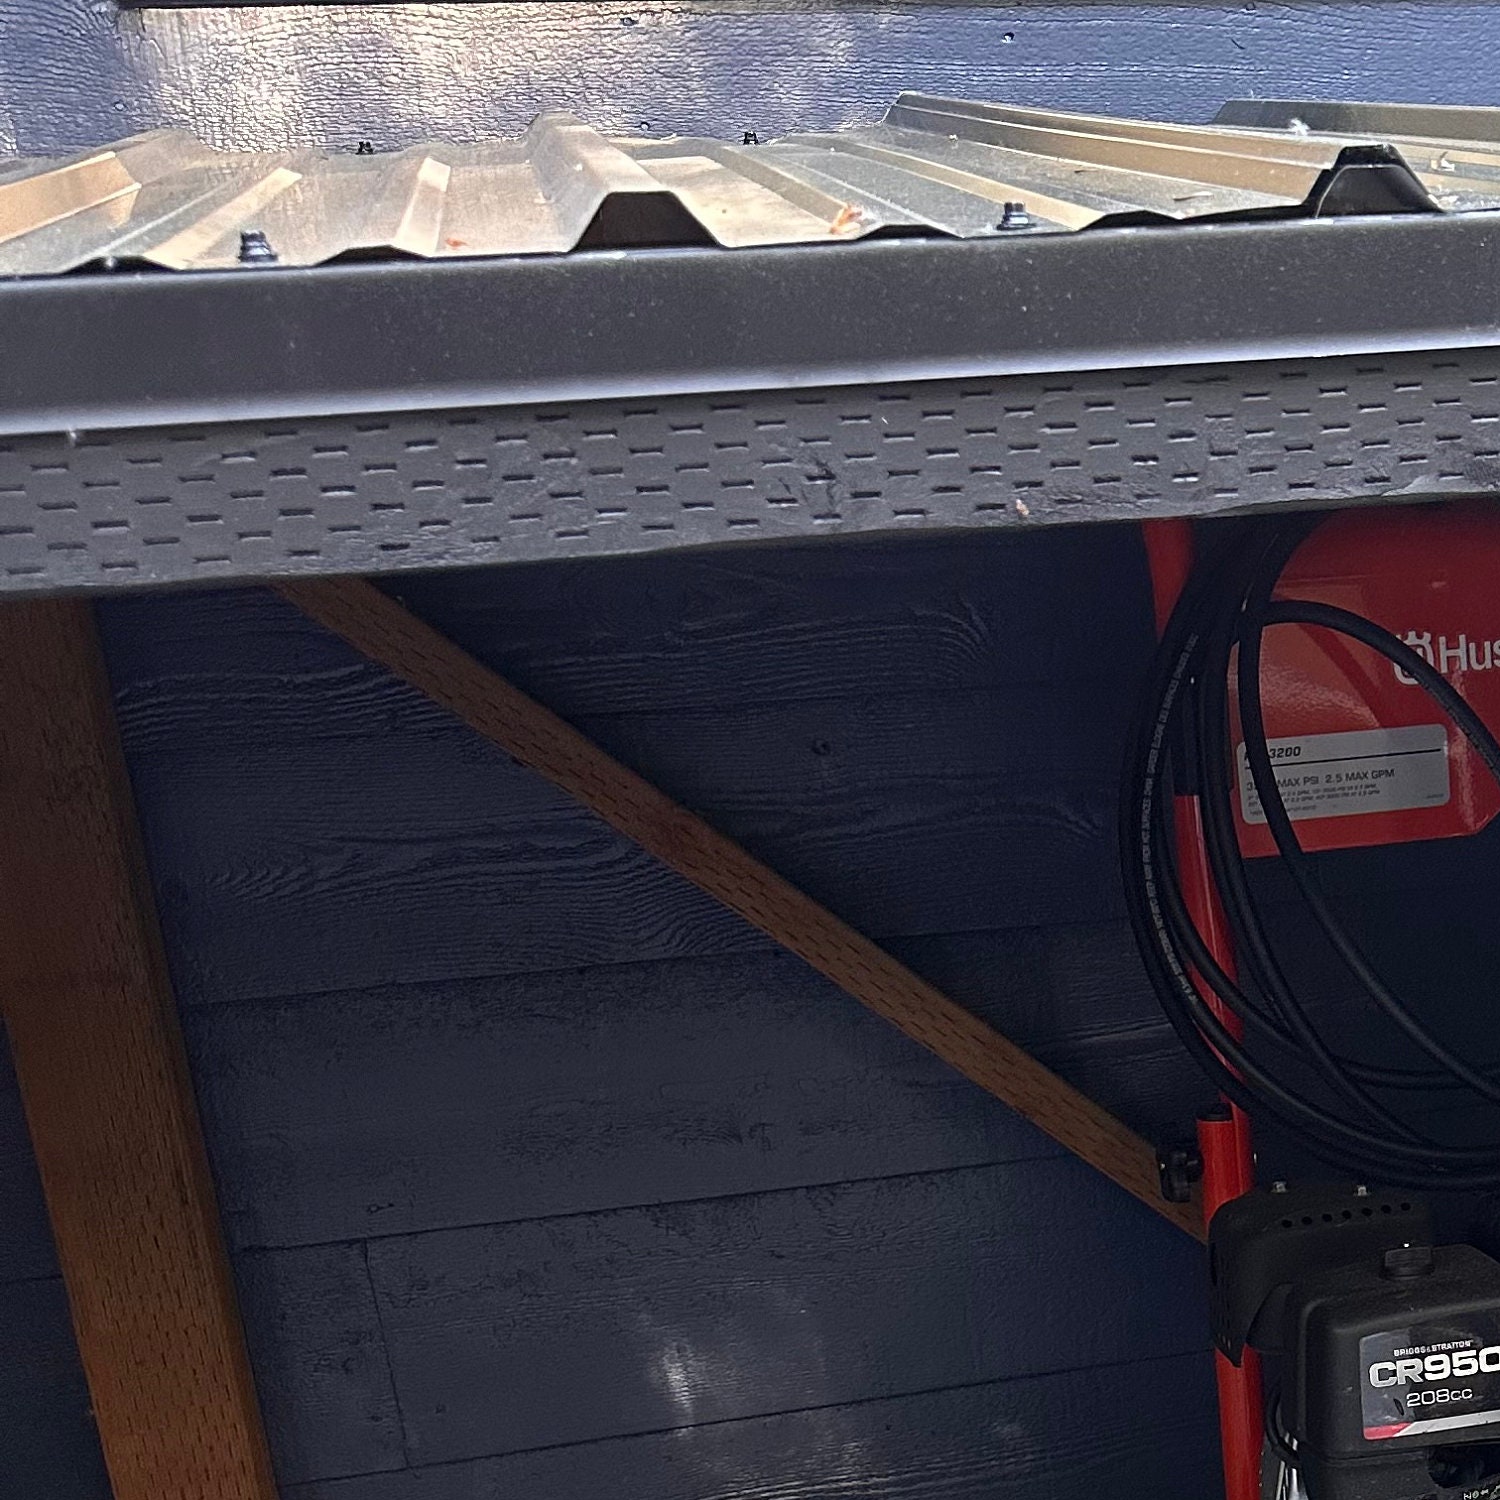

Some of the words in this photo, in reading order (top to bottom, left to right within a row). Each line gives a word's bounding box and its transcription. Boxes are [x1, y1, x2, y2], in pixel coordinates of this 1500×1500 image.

[1303, 775, 1319, 786] PSI
[1325, 773, 1343, 784] 2.5
[1345, 771, 1369, 781] MAX
[1372, 768, 1395, 779] GPM
[1406, 1388, 1473, 1408] 208cc
